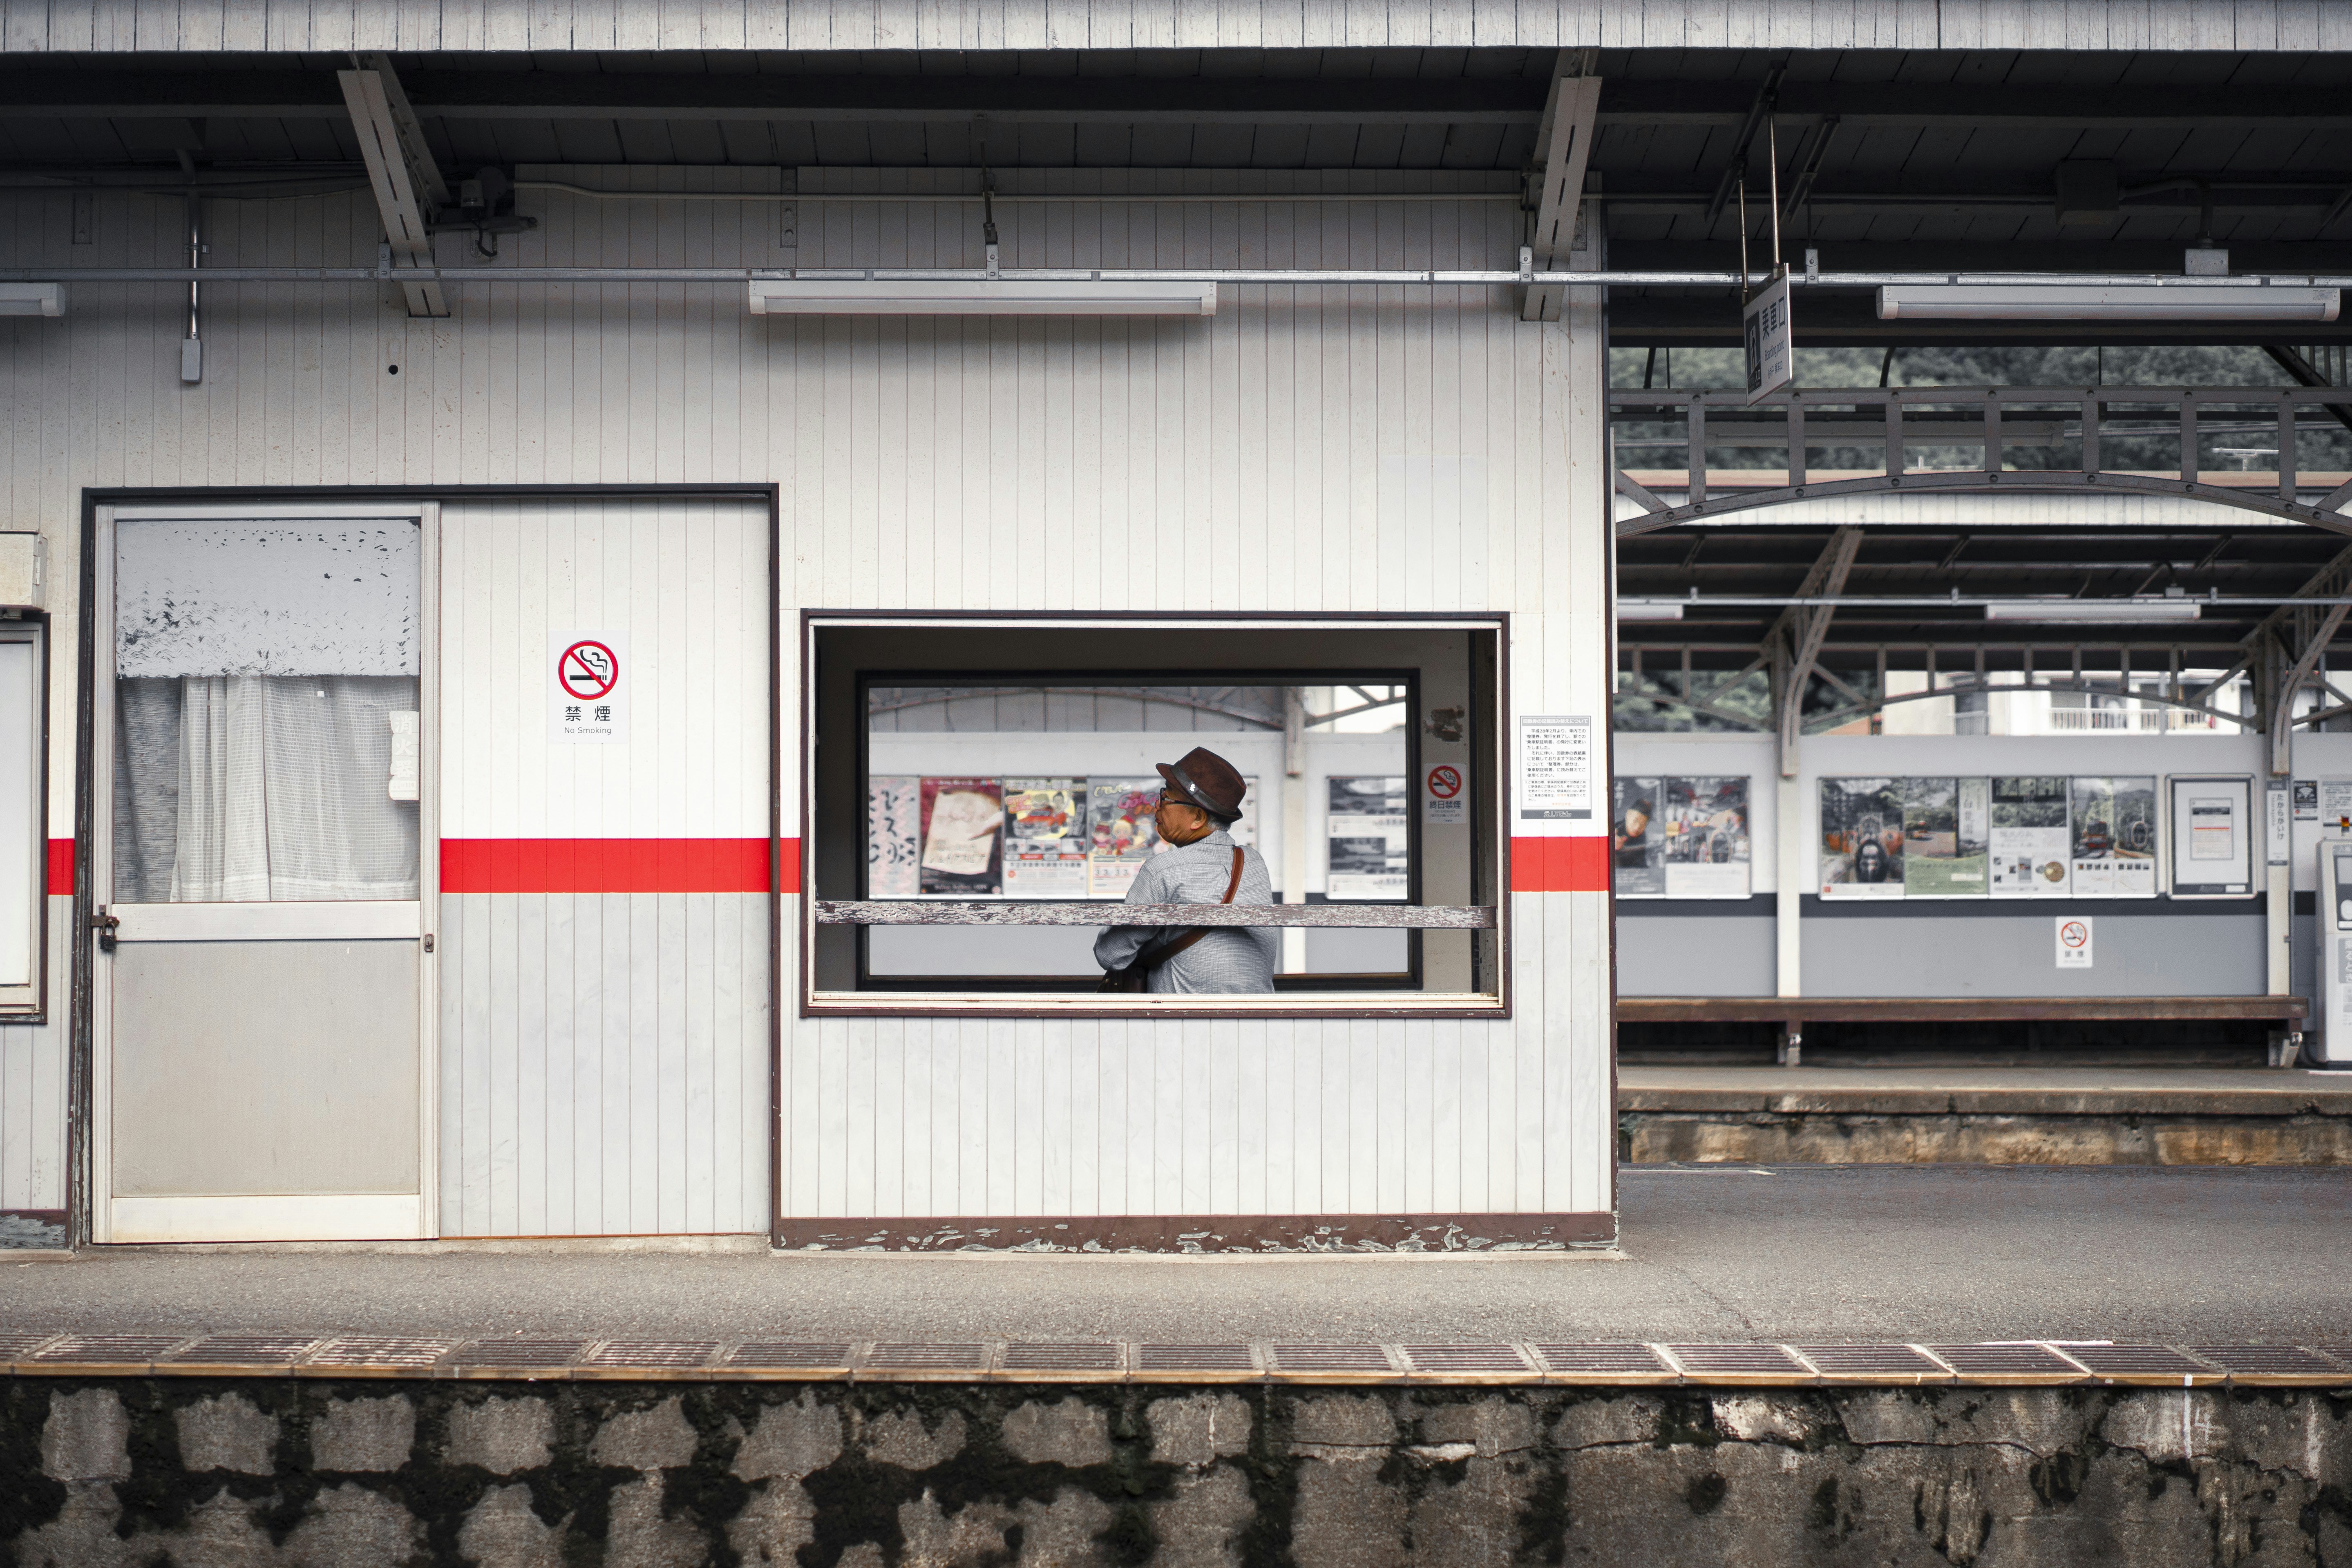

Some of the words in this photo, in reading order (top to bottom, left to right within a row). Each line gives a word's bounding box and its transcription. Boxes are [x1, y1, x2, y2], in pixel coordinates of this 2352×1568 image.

[1762, 296, 1785, 340] 乗車口
[1764, 345, 1777, 361] Boarding
[565, 705, 610, 721] 禁煙
[395, 714, 416, 778] 消火器
[1429, 801, 1461, 809] 終日禁煙
